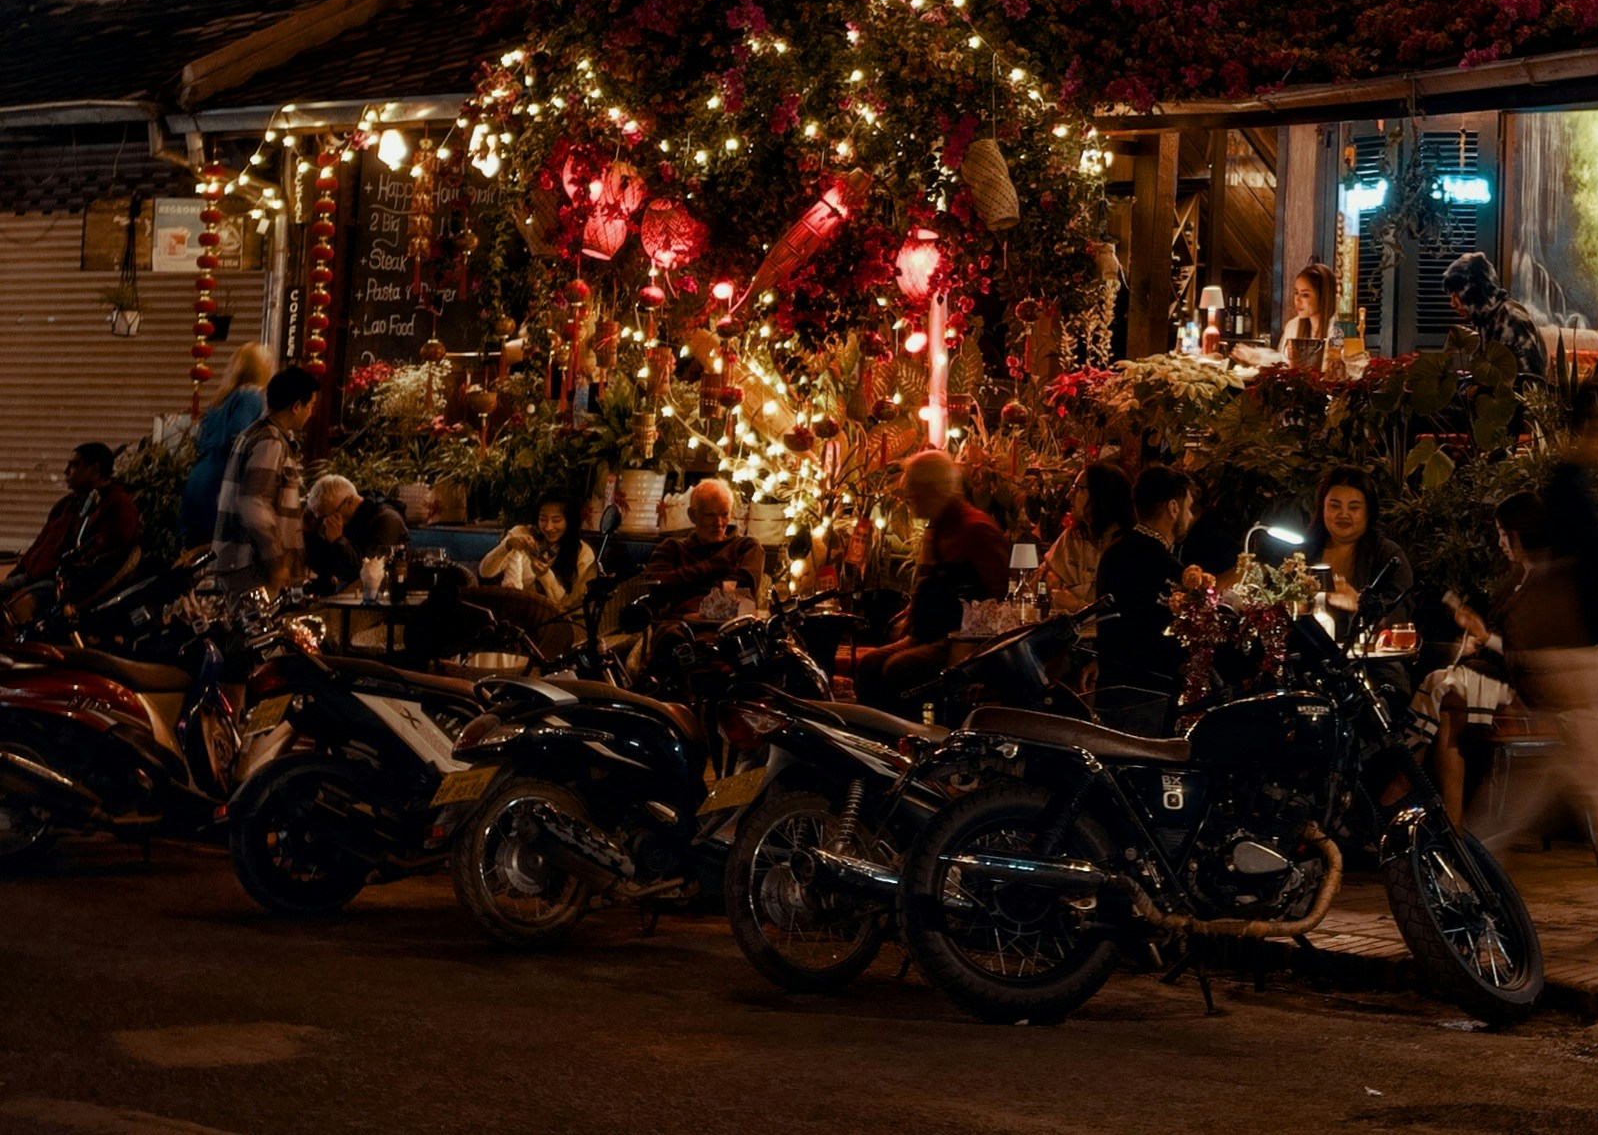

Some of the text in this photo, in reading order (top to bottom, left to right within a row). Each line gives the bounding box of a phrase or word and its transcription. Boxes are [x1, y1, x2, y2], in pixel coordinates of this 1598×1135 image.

[374, 173, 415, 213] Happ
[369, 212, 379, 231] 2
[369, 248, 409, 273] Steak
[365, 277, 401, 303] Pasta
[286, 289, 300, 357] COFFEE
[363, 313, 416, 337] Lao Food
